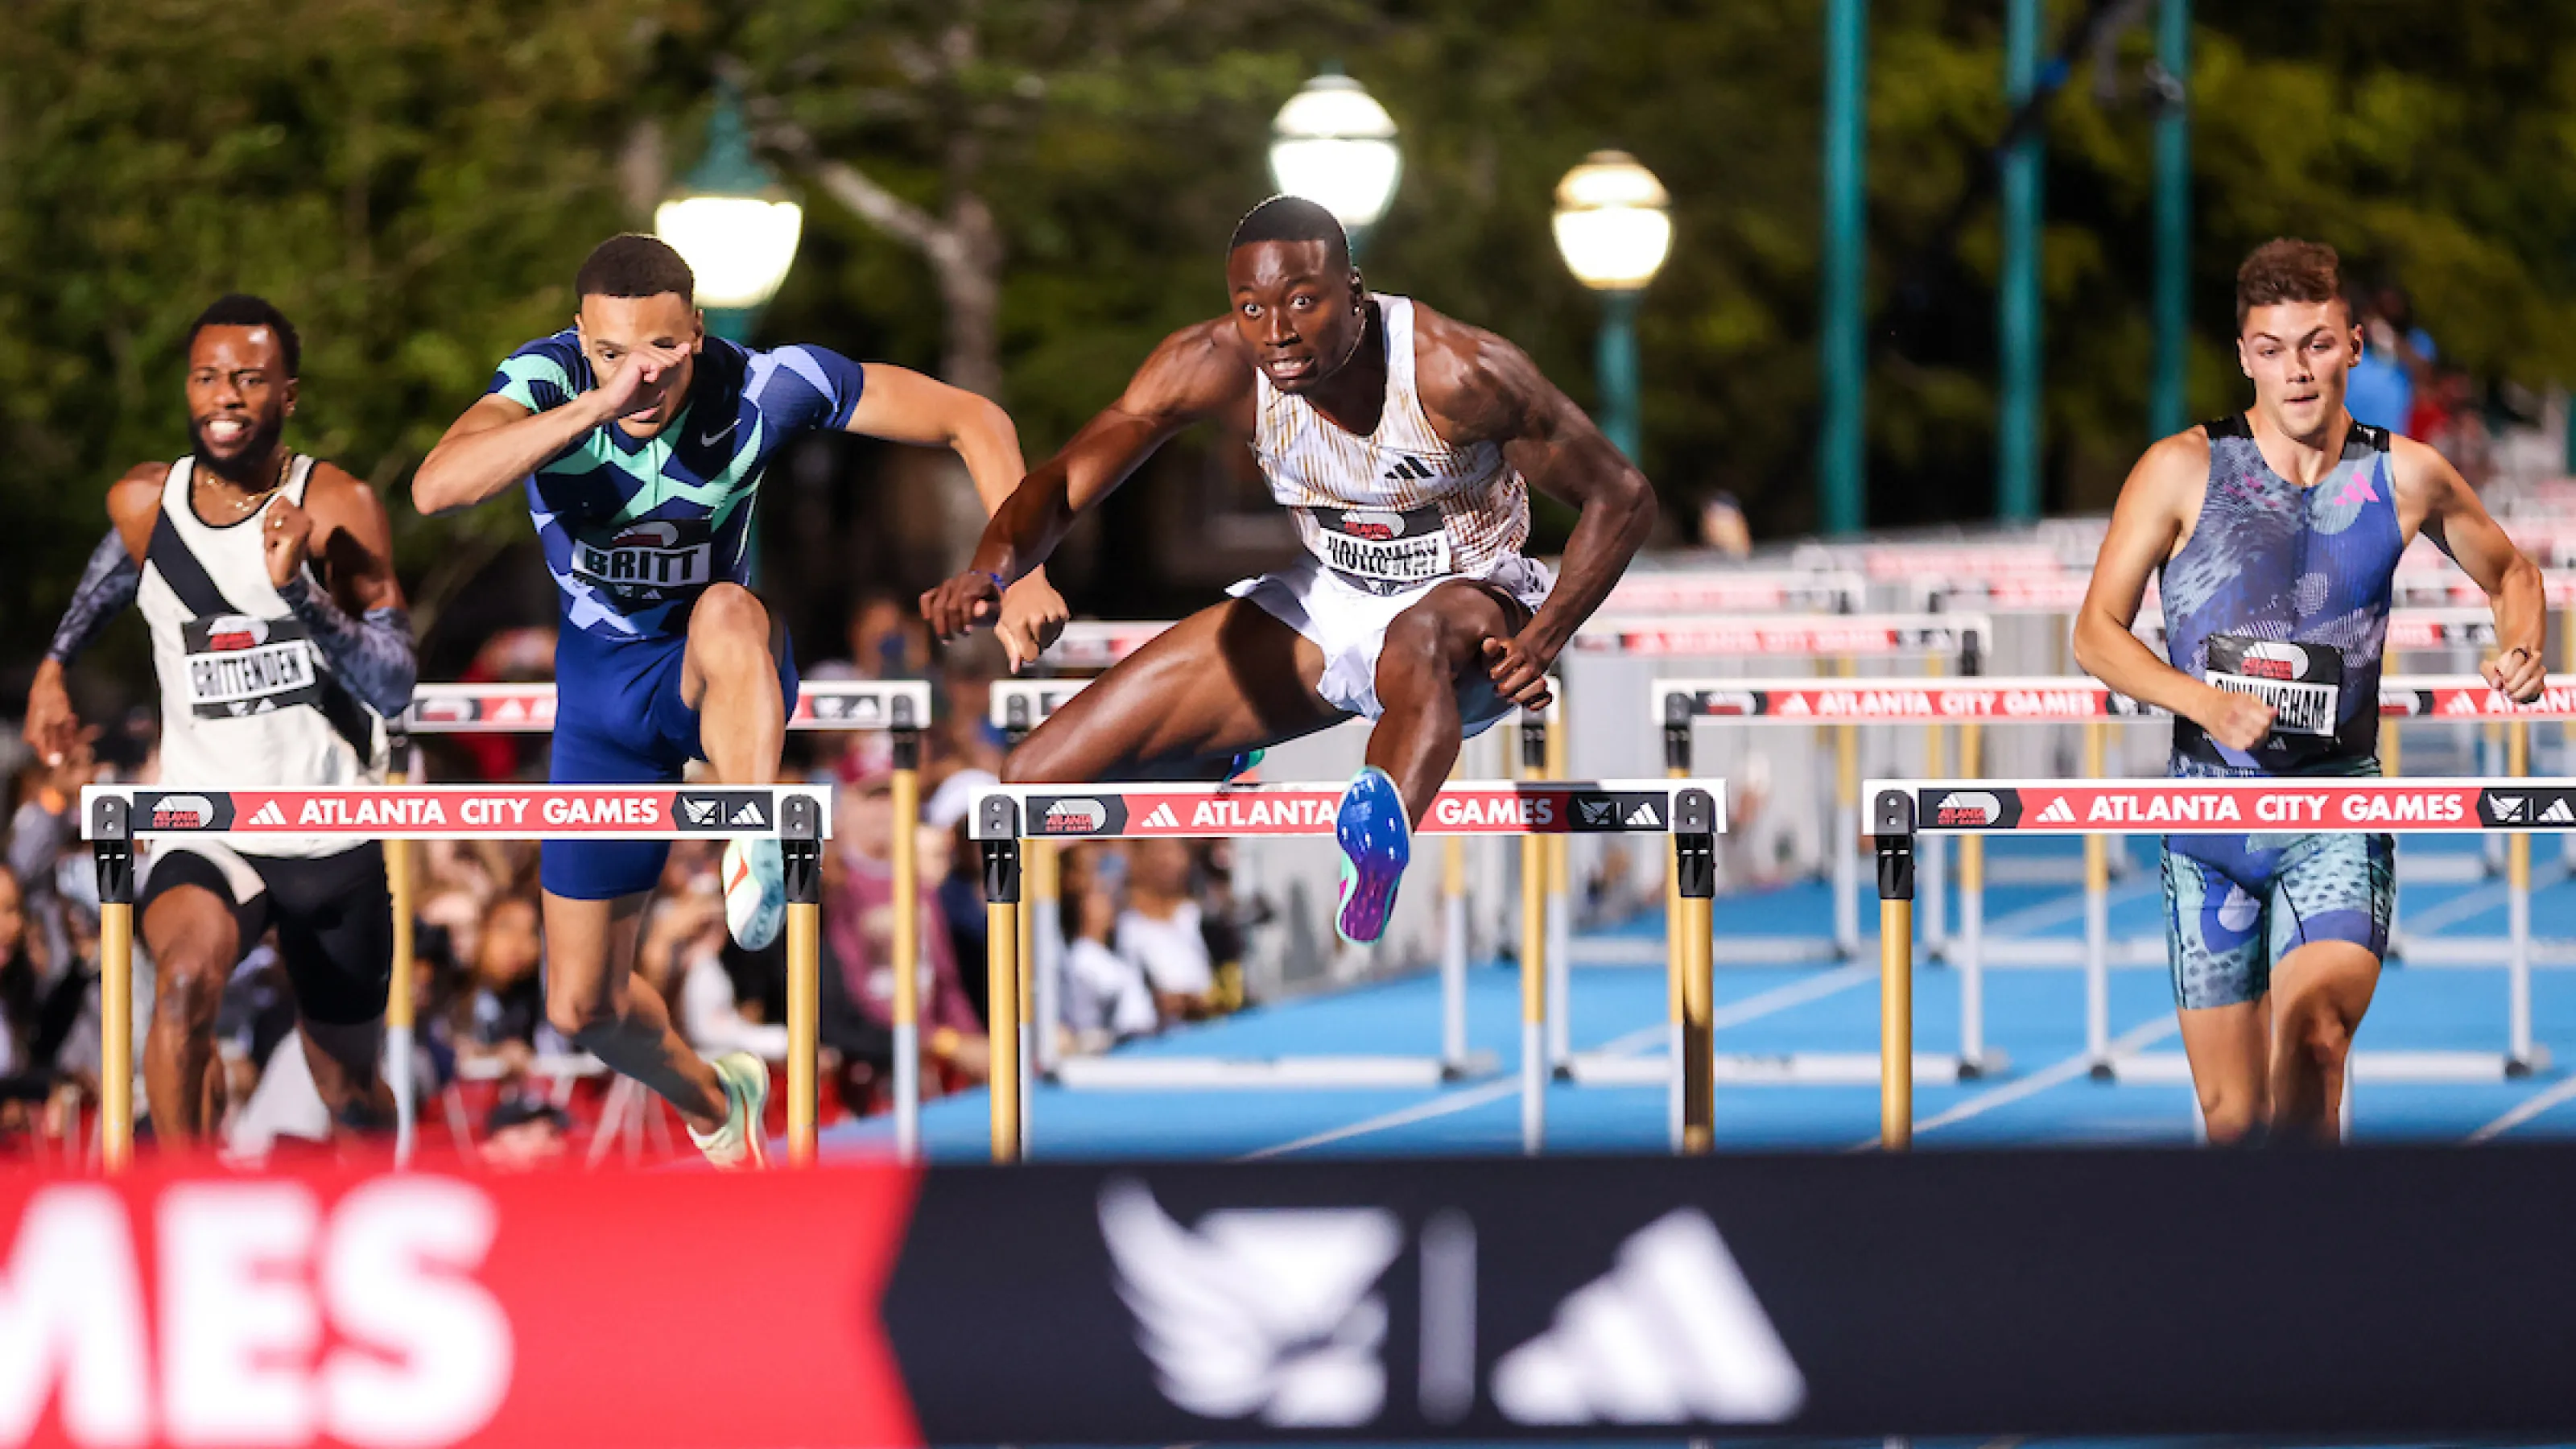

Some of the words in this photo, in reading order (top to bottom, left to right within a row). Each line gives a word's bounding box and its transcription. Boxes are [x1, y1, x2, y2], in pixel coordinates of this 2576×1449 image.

[585, 548, 699, 582] BRITT
[1327, 536, 1439, 576] HOLLOWAY
[1817, 691, 1931, 716] ATLANTA
[1940, 691, 1996, 716] CITY
[2002, 691, 2096, 716] GAMES
[2215, 678, 2328, 730] NGHAM
[298, 798, 447, 824] ATLANTA
[460, 798, 530, 824] CITY
[543, 798, 659, 824] GAMES
[1191, 799, 1336, 826] ATLANTA
[1436, 799, 1553, 825] GAMES
[2087, 795, 2241, 821] ATLANTA
[2256, 795, 2329, 821] CITY
[2341, 795, 2463, 821] GAMES
